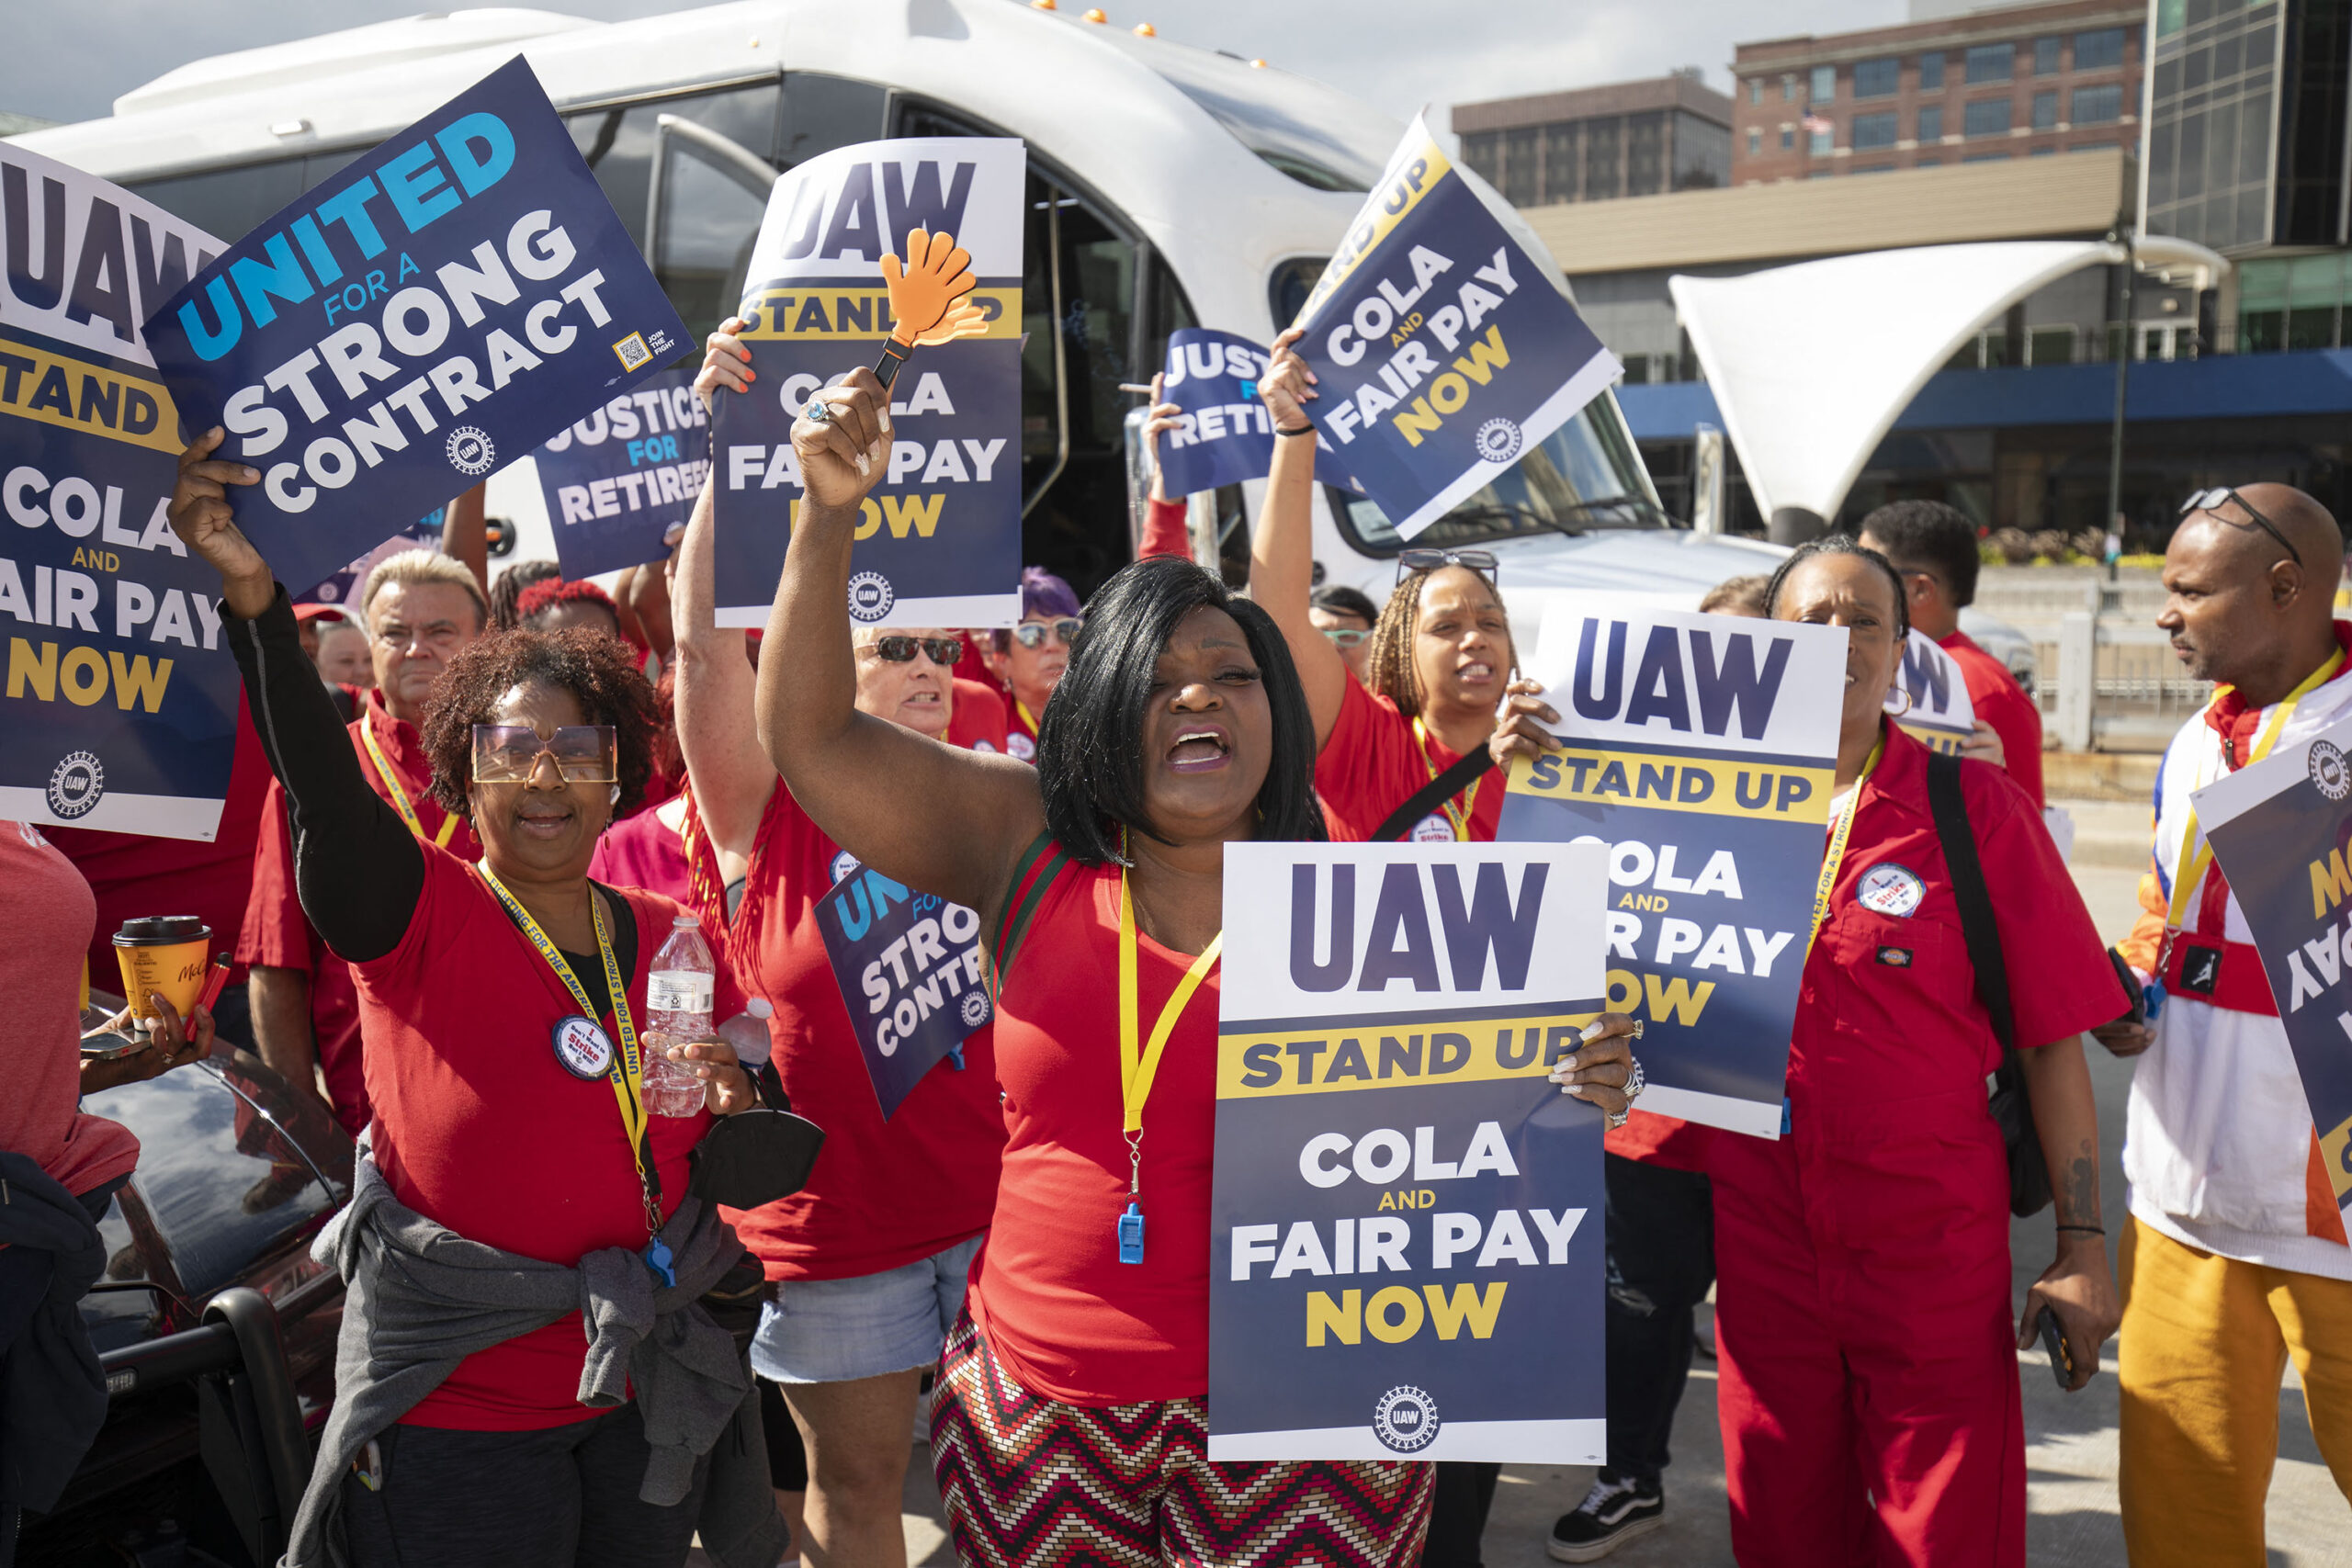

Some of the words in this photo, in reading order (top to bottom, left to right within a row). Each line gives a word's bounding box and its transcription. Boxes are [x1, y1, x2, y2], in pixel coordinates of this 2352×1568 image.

[1384, 158, 1427, 215] UP
[176, 112, 515, 361] UNITED
[782, 161, 977, 264] UAW
[323, 269, 390, 326] FOR
[399, 252, 421, 284] A
[967, 297, 1003, 322] P
[1327, 244, 1454, 367] COLA
[222, 209, 577, 457] STRONG
[648, 330, 664, 344] JOIN
[650, 337, 665, 349] THE
[654, 339, 675, 355] FIGHT
[1323, 340, 1440, 445] FAIR
[1426, 246, 1519, 353] PAY
[1390, 312, 1423, 348] AND
[265, 268, 612, 513] CONTRACT
[1163, 342, 1272, 388] JUST
[1393, 323, 1510, 447] NOW
[0, 351, 160, 435] TAND
[780, 372, 956, 418] CA
[459, 442, 480, 460] UAW
[627, 434, 679, 467] FOR
[729, 444, 806, 491] FA
[888, 438, 1007, 484] PAY
[3, 466, 188, 558] COLA
[789, 493, 946, 541] OW
[72, 547, 120, 573] AND
[0, 558, 100, 633] AIR
[116, 580, 224, 650] PAY
[858, 591, 879, 601] UAW
[6, 637, 175, 713] NOW
[1573, 617, 1794, 740] UAW
[64, 775, 88, 791] UAW
[1527, 754, 1715, 803] STAND
[1735, 771, 1813, 812] UP
[1569, 835, 1743, 899] OLA
[1819, 873, 1833, 896] FOR
[1828, 860, 1837, 868] A
[912, 893, 942, 920] FO
[1618, 892, 1669, 912] AND
[1876, 882, 1907, 905] Strike
[490, 877, 530, 928] FIGHTING
[527, 924, 548, 950] FOR
[545, 947, 567, 972] THE
[1290, 863, 1550, 992] UAW
[1655, 917, 1795, 977] PAY
[603, 946, 621, 988] STRONG
[862, 902, 979, 1014] STRO
[614, 991, 624, 999] A
[616, 1002, 630, 1023] FOR
[1606, 969, 1716, 1027] OW
[568, 1032, 600, 1062] Strike
[571, 1024, 585, 1038] Don't
[589, 1028, 594, 1037] I
[622, 1027, 639, 1076] UNITED
[1240, 1032, 1472, 1089] STAND
[1495, 1025, 1586, 1070] UP
[1299, 1121, 1520, 1188] COLA
[1377, 1190, 1436, 1211] AND
[1231, 1216, 1412, 1281] FAIR
[1432, 1208, 1588, 1269] PAY
[1306, 1281, 1508, 1348] NOW
[1393, 1410, 1419, 1424] UAW
